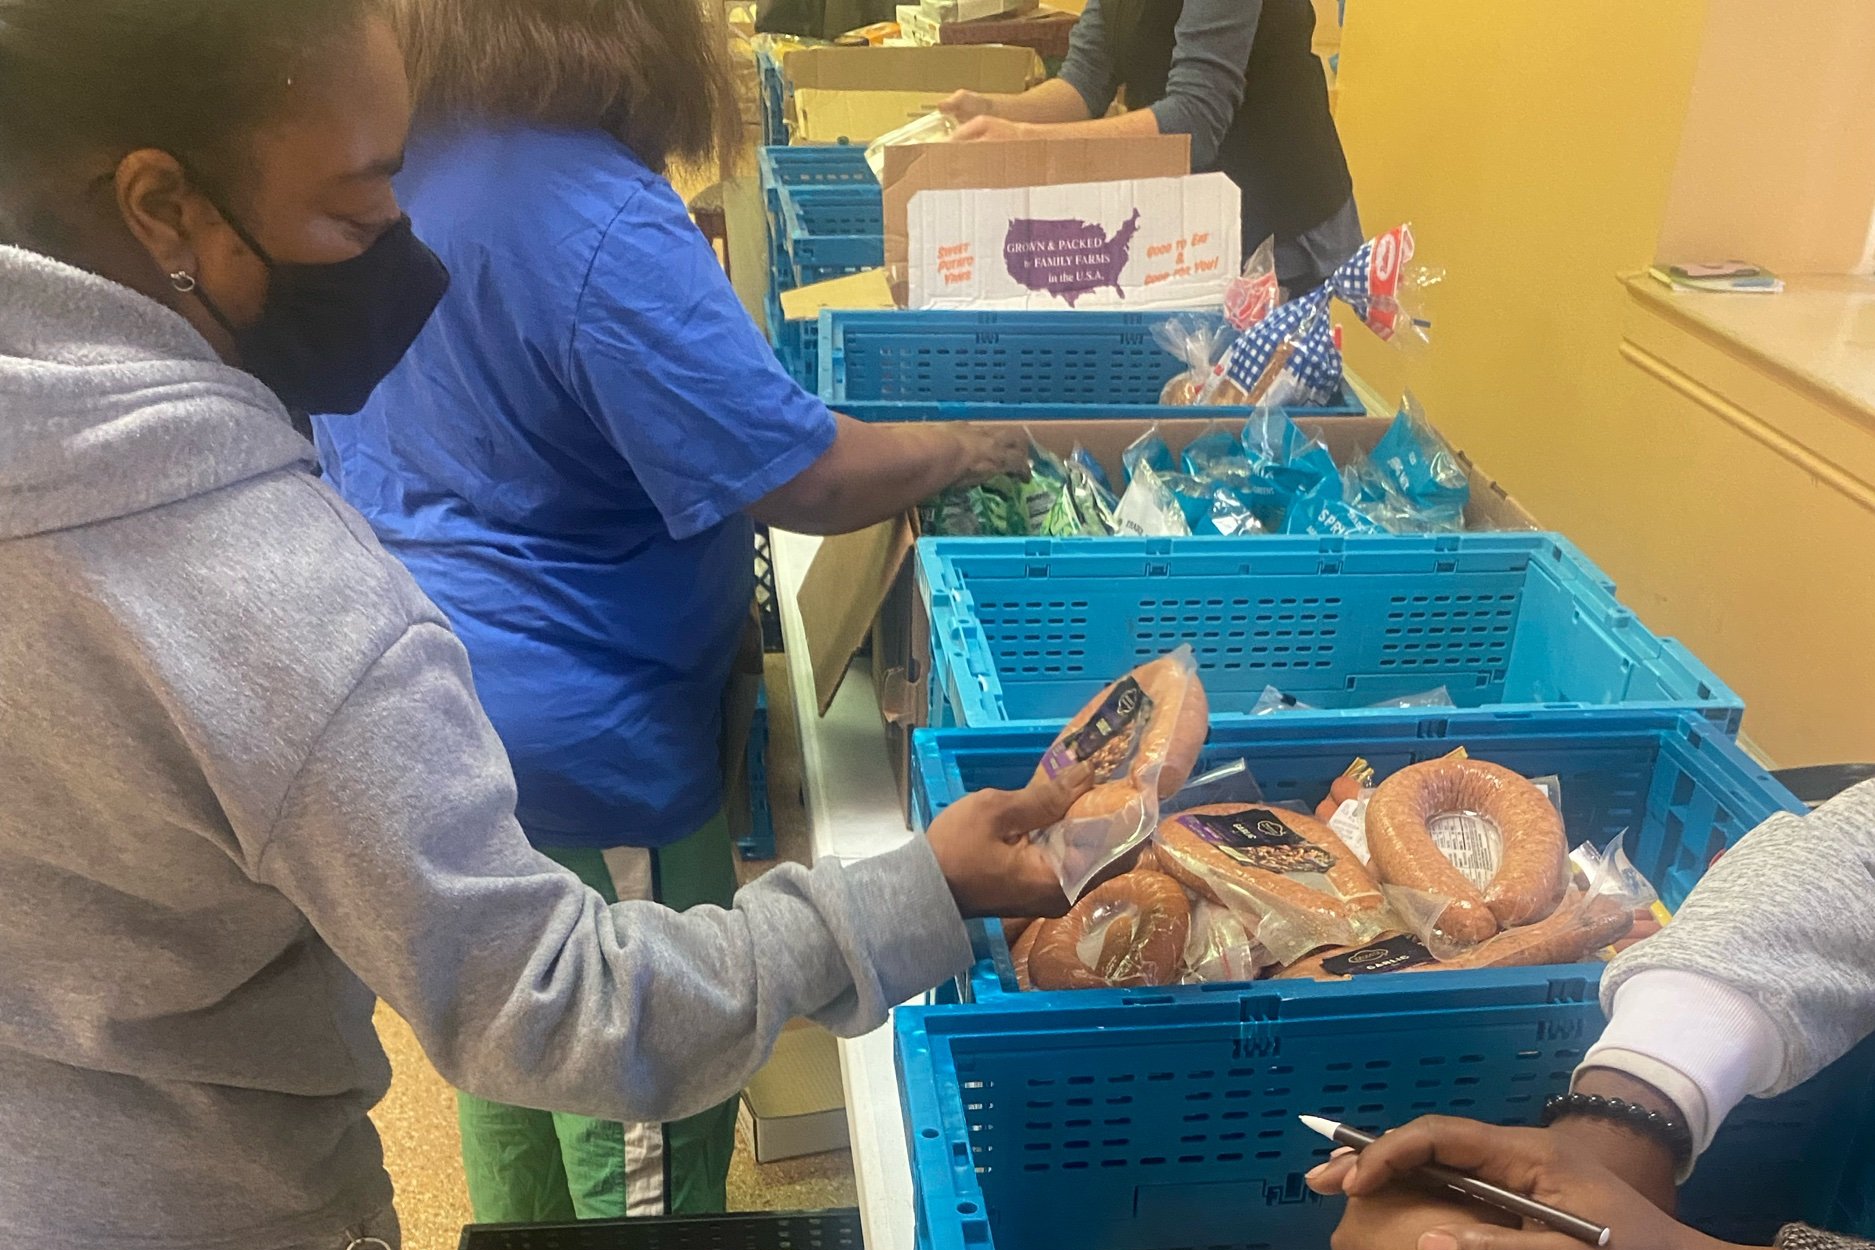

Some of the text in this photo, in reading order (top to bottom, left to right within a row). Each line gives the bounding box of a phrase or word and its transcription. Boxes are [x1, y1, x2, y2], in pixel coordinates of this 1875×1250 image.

[1006, 237, 1103, 253] GROWN & PACKED
[1034, 255, 1073, 269] FAMILY
[1075, 252, 1111, 266] FARMS
[1048, 269, 1105, 283] in the U.S.A.
[1366, 955, 1410, 970] GARLIC
